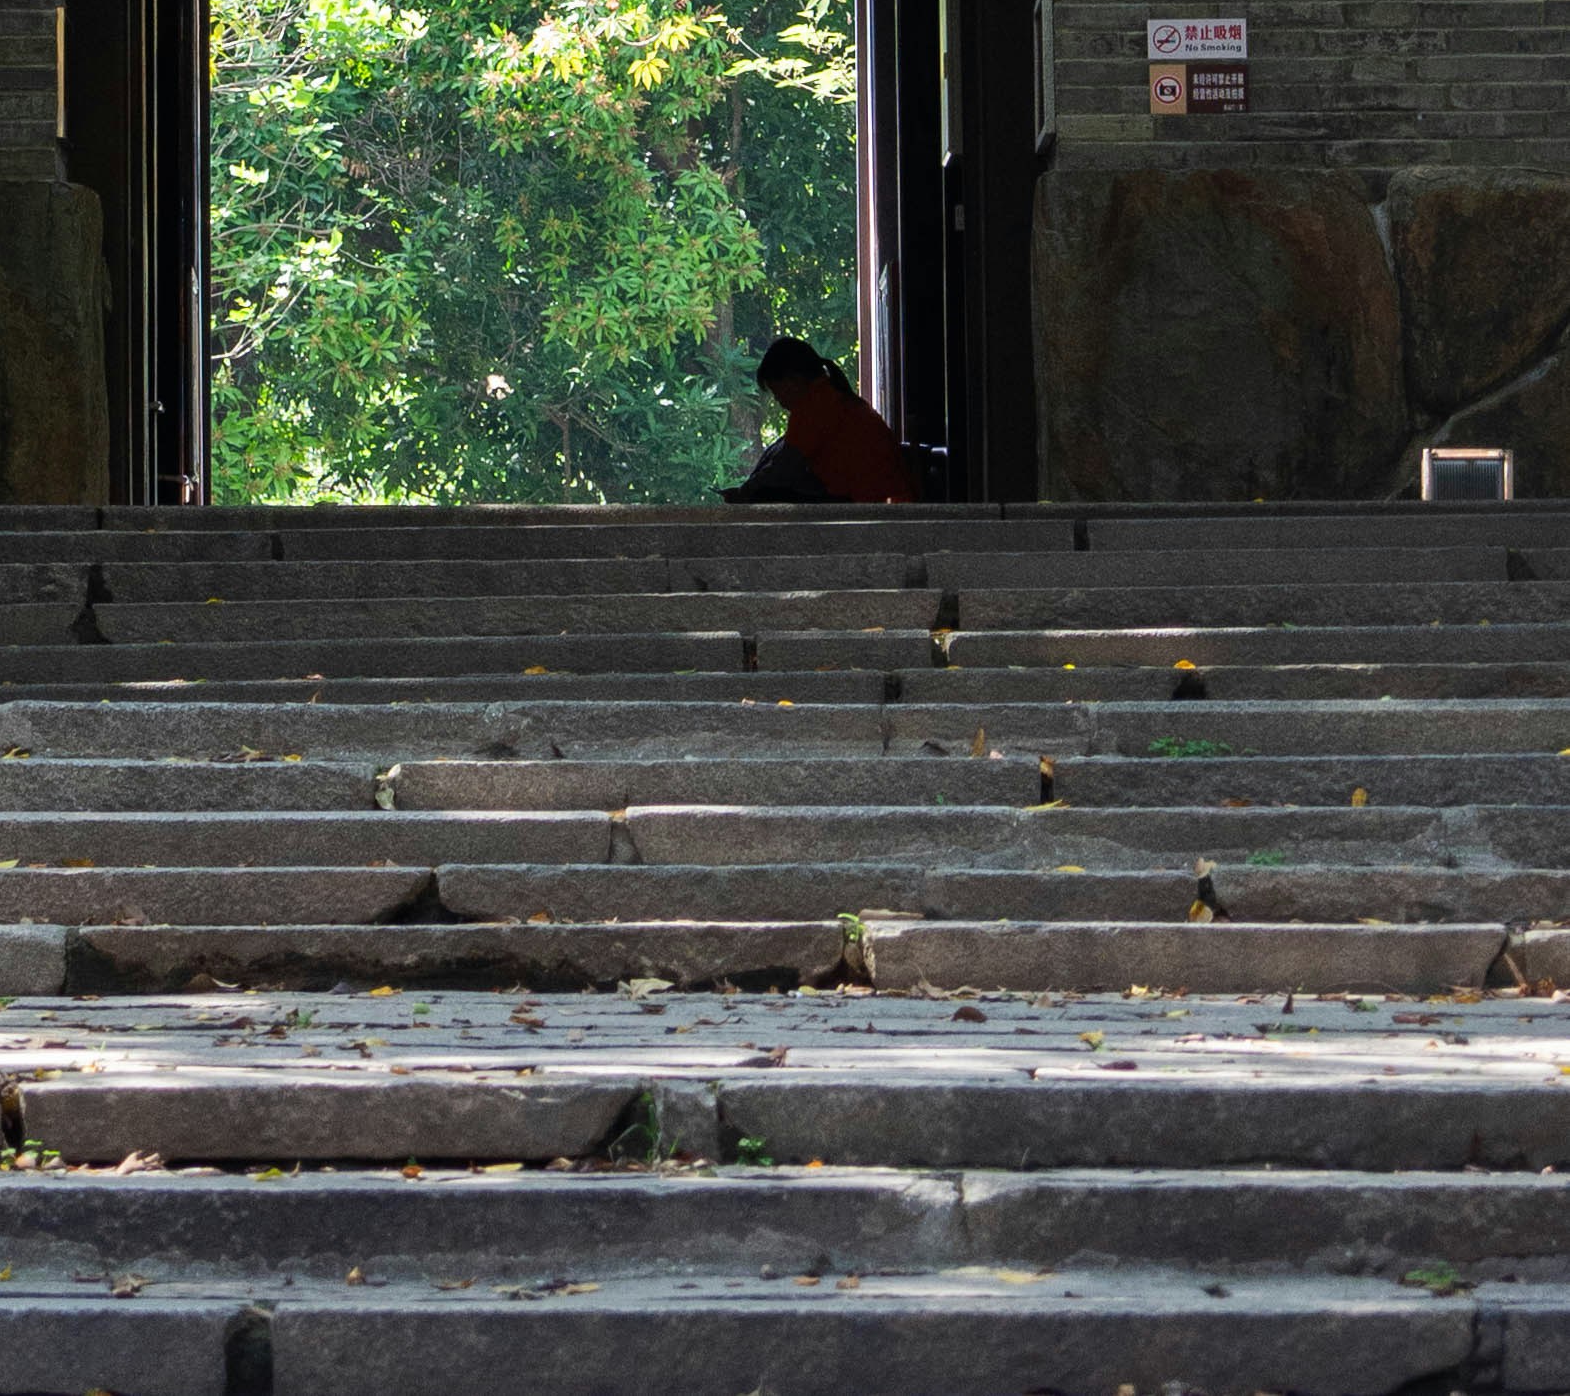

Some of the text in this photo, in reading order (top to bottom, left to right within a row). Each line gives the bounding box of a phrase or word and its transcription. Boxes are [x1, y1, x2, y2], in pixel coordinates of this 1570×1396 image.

[1185, 24, 1242, 41] 禁止吸烟
[1185, 43, 1242, 53] No Smoking
